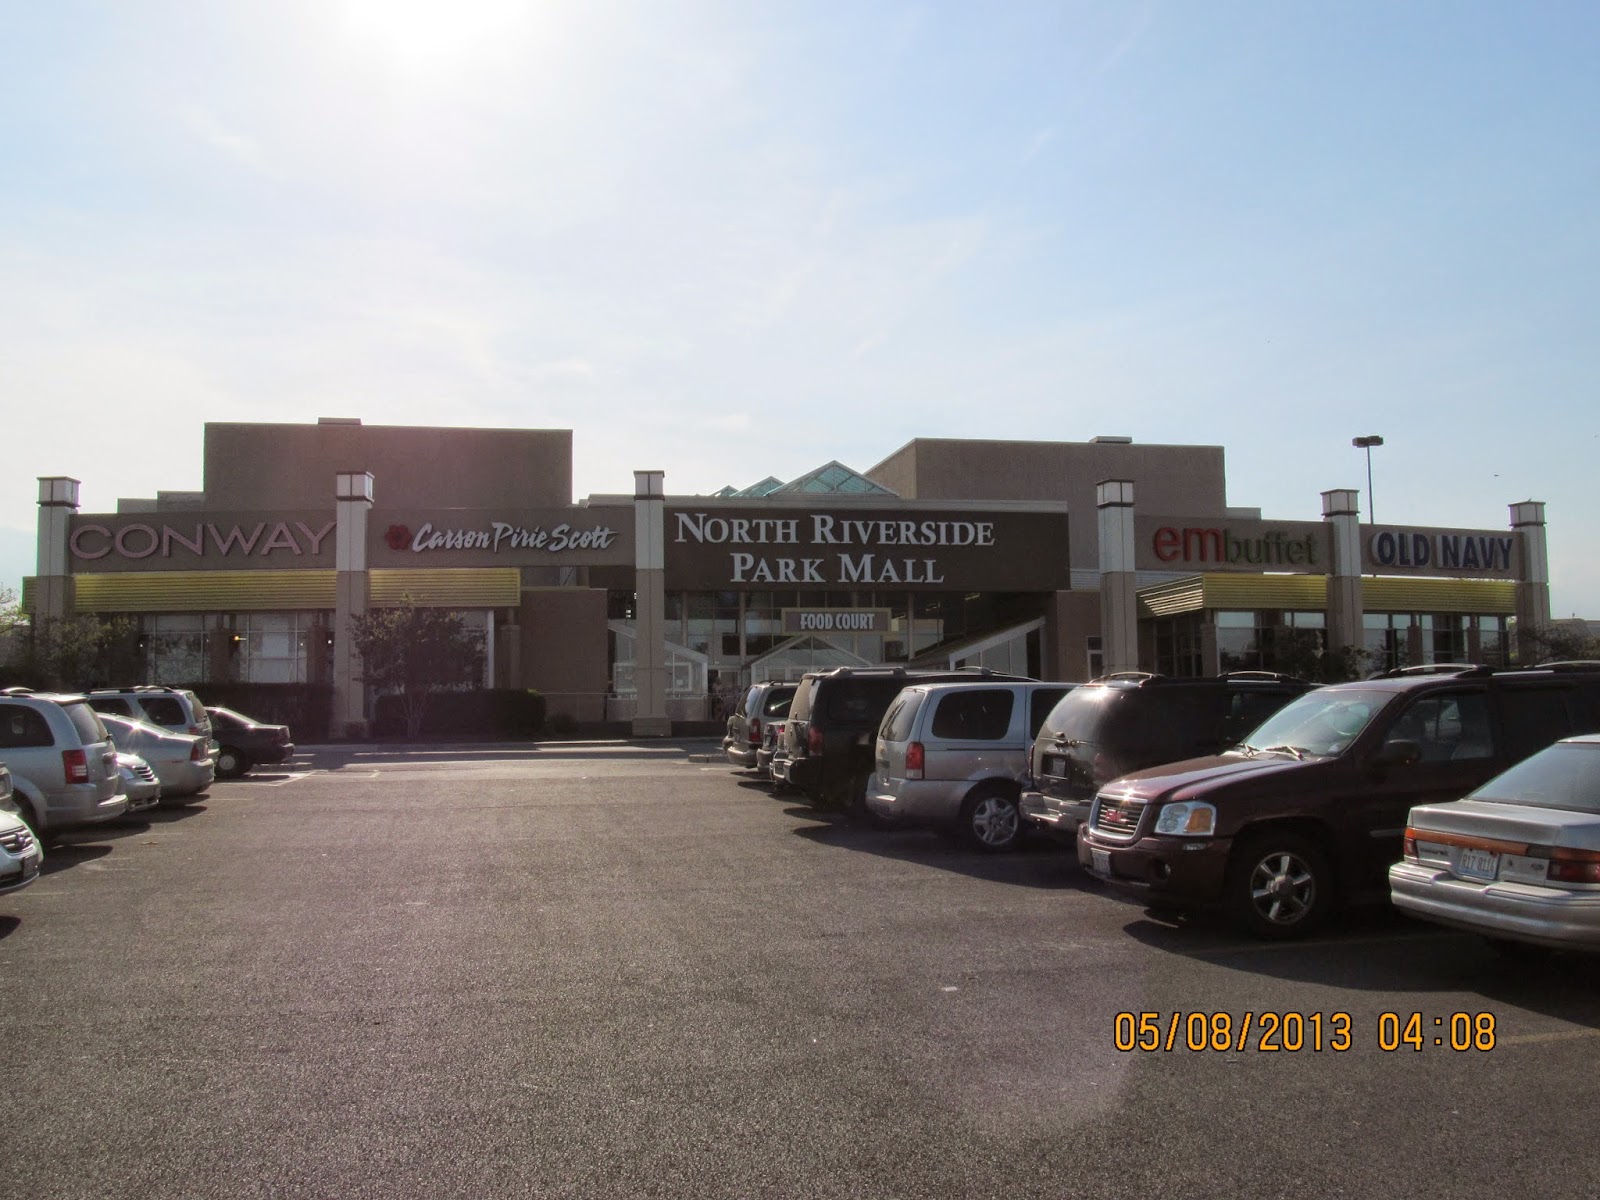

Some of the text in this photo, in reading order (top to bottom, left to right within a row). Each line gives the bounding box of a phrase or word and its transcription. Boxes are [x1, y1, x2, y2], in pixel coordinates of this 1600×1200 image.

[69, 521, 337, 559] CONWAY
[412, 521, 618, 553] Carson Pirie Scott
[674, 512, 996, 546] NORTH RIVERSIDE
[1373, 531, 1513, 570] OLD NAVY
[729, 552, 944, 583] PARK MALL
[800, 613, 875, 630] FOOD COURT
